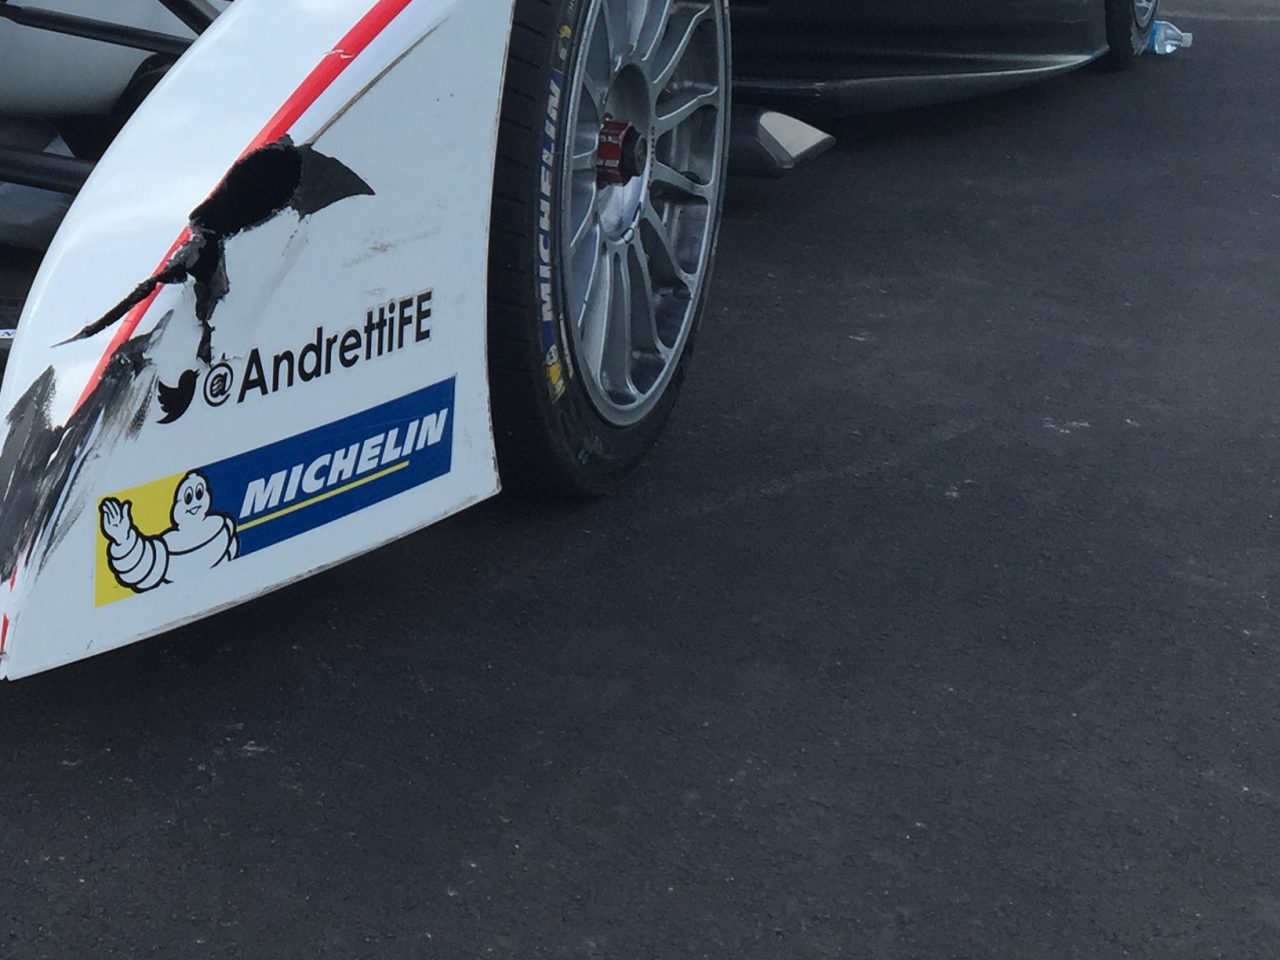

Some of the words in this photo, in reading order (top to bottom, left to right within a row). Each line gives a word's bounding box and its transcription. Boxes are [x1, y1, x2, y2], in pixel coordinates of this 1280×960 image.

[538, 78, 562, 324] MICHELIN
[203, 290, 432, 407] @AndrettiFE
[239, 407, 449, 519] MICHELIN
